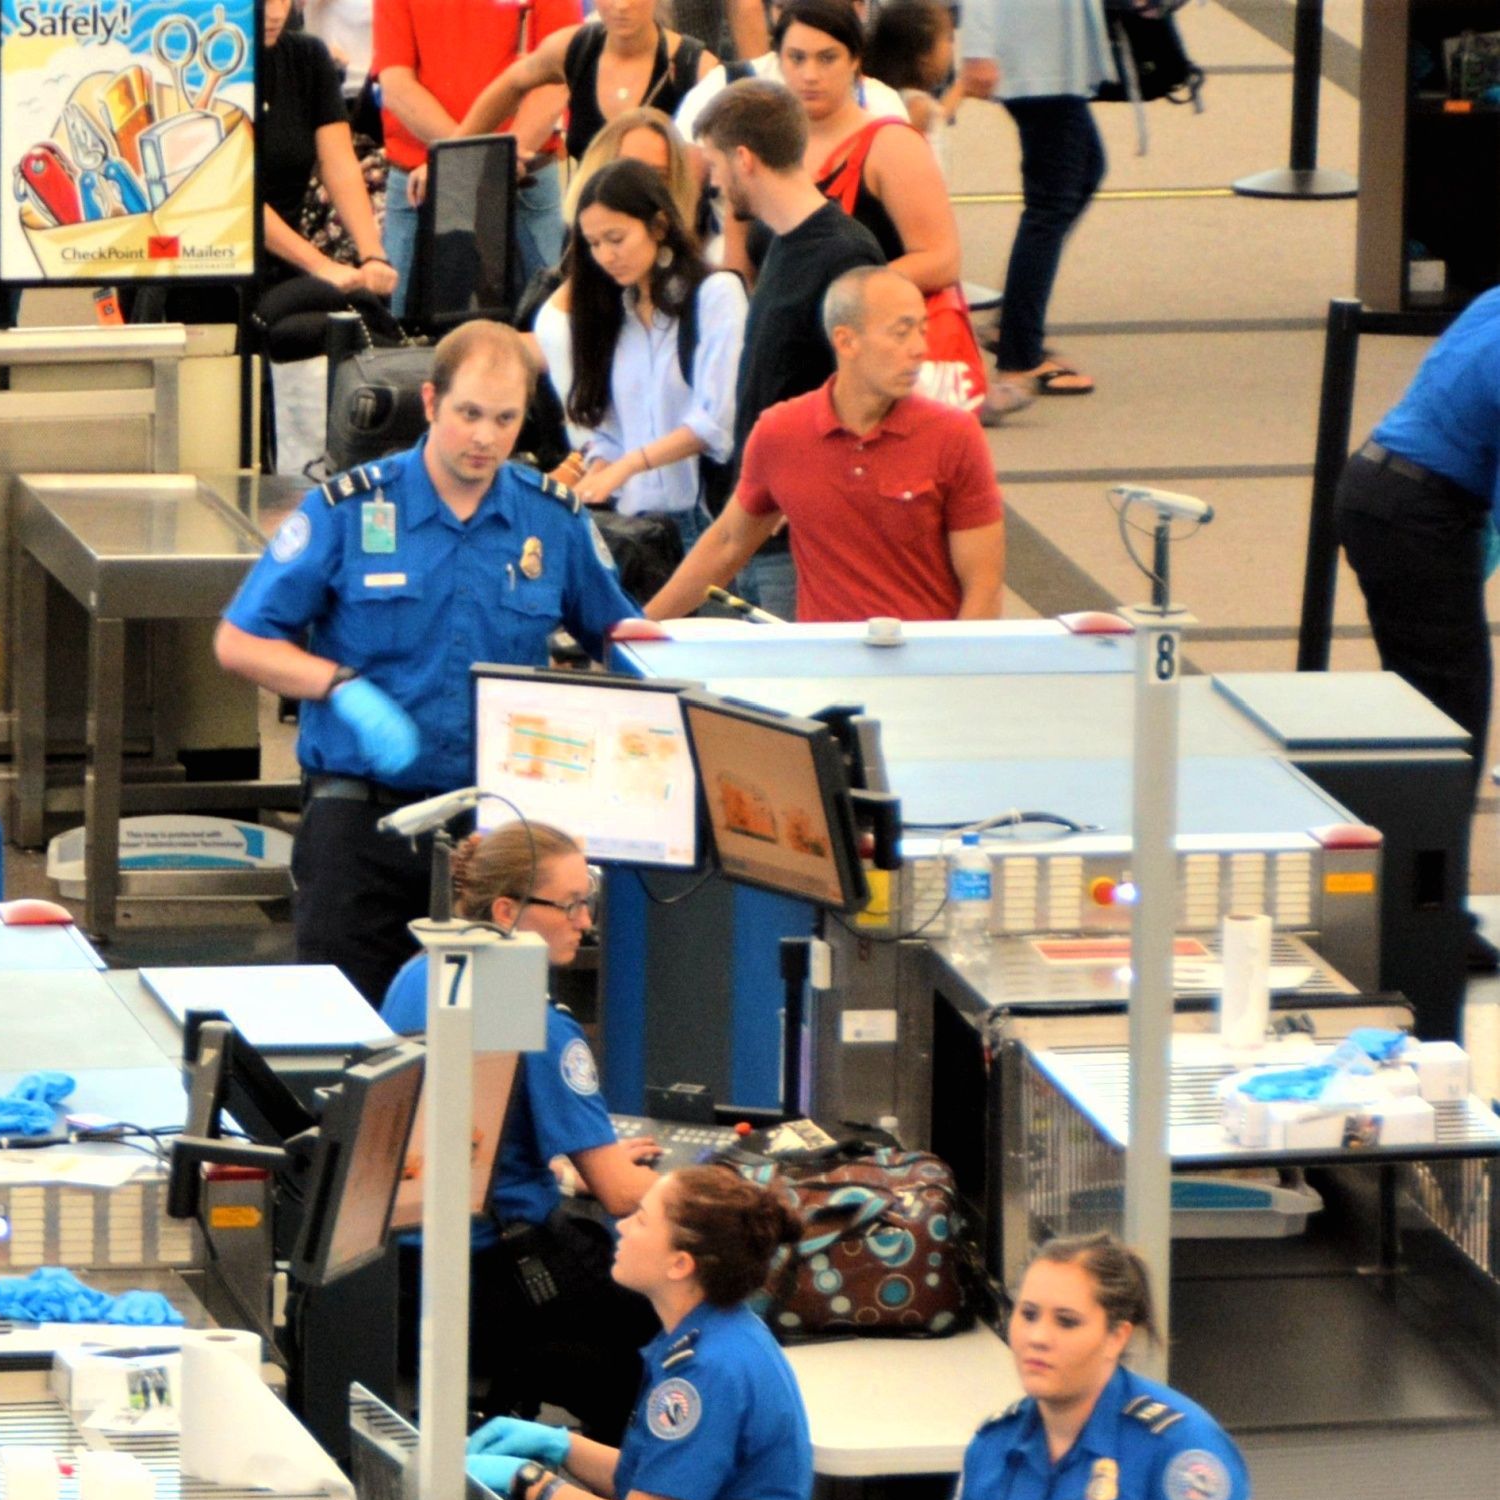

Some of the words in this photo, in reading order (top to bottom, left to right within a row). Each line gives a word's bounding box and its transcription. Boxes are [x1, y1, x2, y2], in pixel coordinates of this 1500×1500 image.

[18, 4, 129, 46] Safely!
[60, 246, 144, 261] CheckPoint
[182, 245, 236, 259] Mailers
[1155, 632, 1175, 682] 8
[444, 953, 468, 1007] 7
